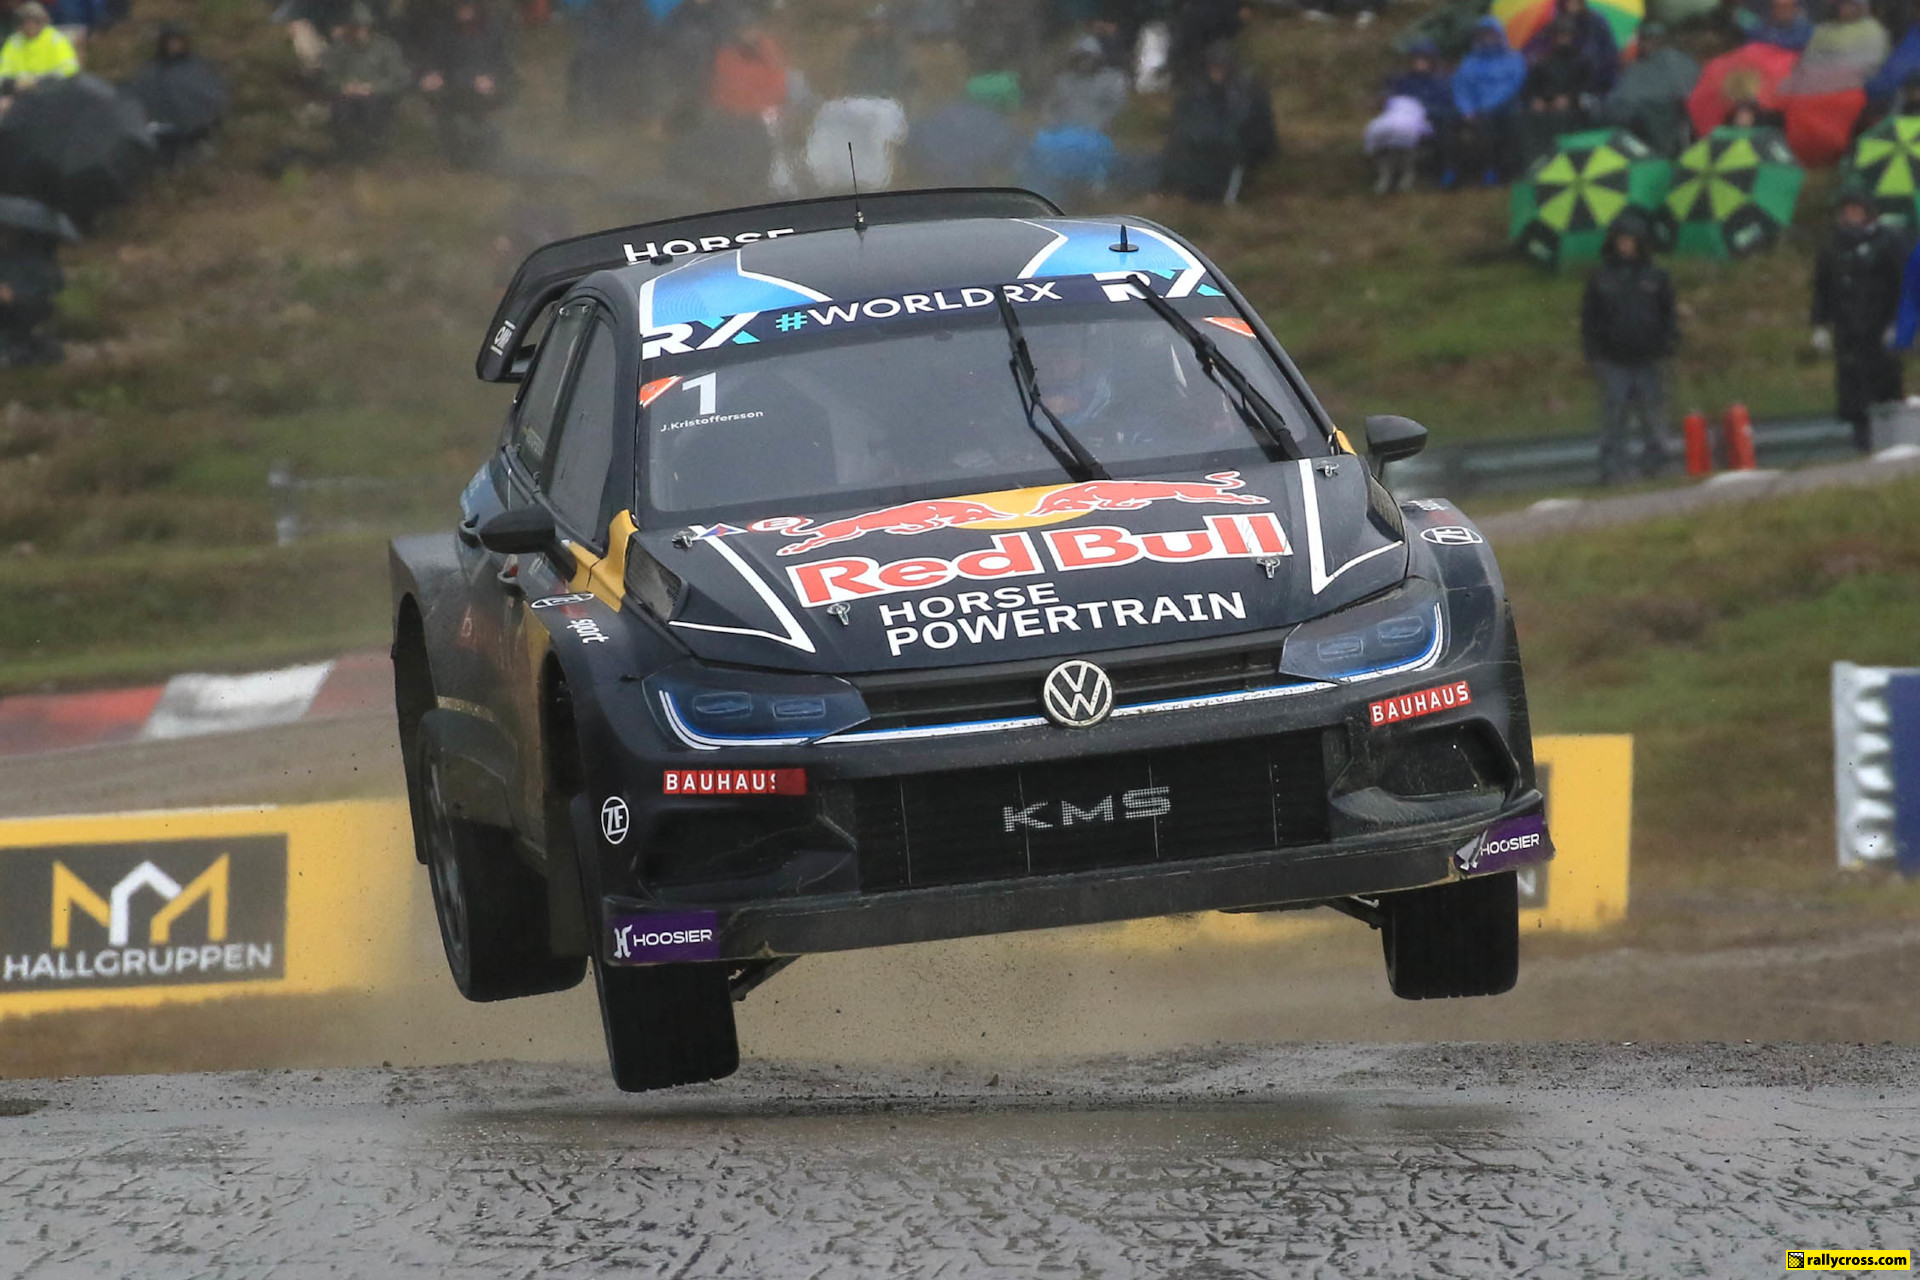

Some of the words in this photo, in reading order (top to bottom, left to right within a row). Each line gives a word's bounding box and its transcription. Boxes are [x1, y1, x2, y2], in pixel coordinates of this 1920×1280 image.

[775, 280, 1063, 332] #WORLDRX
[682, 372, 717, 416] 1
[791, 534, 1041, 604] Red
[1046, 514, 1291, 570] Bull
[878, 582, 1061, 626] HORSE
[885, 591, 1247, 657] POWERTRAIN
[566, 618, 610, 644] sport
[1371, 684, 1469, 723] BAUHAUS
[602, 800, 629, 840] ZF
[1003, 786, 1171, 832] KMS
[1480, 833, 1540, 857] HOOSIER
[633, 929, 713, 947] HOOSIER
[2, 943, 273, 981] HALLGRUPPEN
